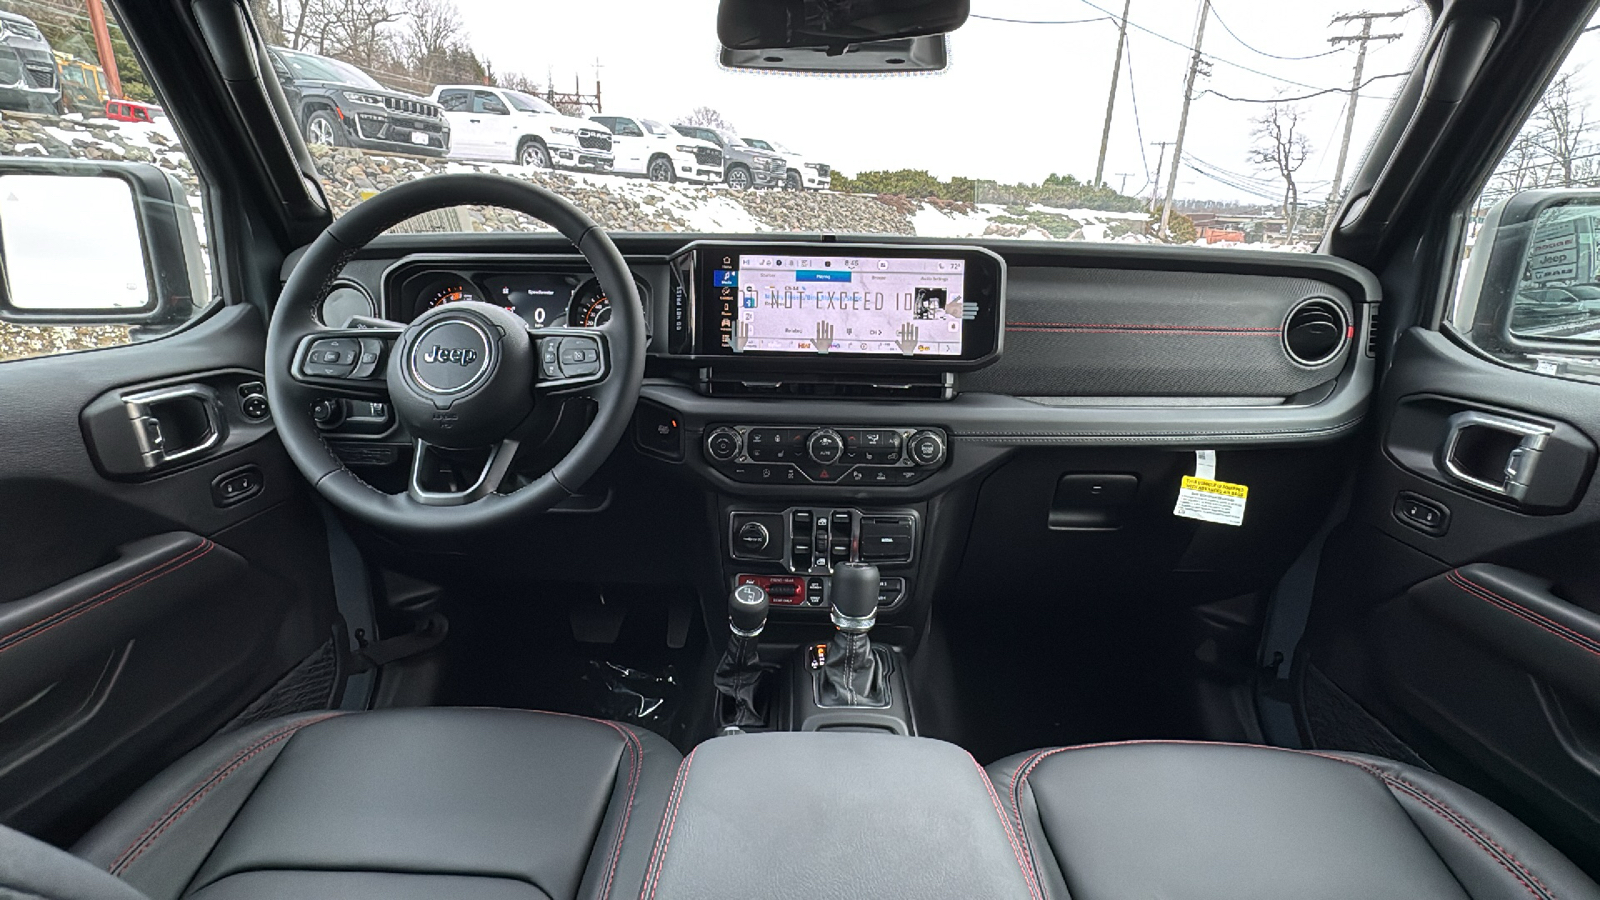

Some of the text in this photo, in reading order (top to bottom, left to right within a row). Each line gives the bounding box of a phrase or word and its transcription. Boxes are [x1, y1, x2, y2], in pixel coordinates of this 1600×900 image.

[1540, 254, 1568, 265] Jeep
[771, 290, 805, 310] NOT
[816, 291, 884, 311] EXCEED
[534, 307, 546, 323] 0
[424, 344, 477, 367] Jeep
